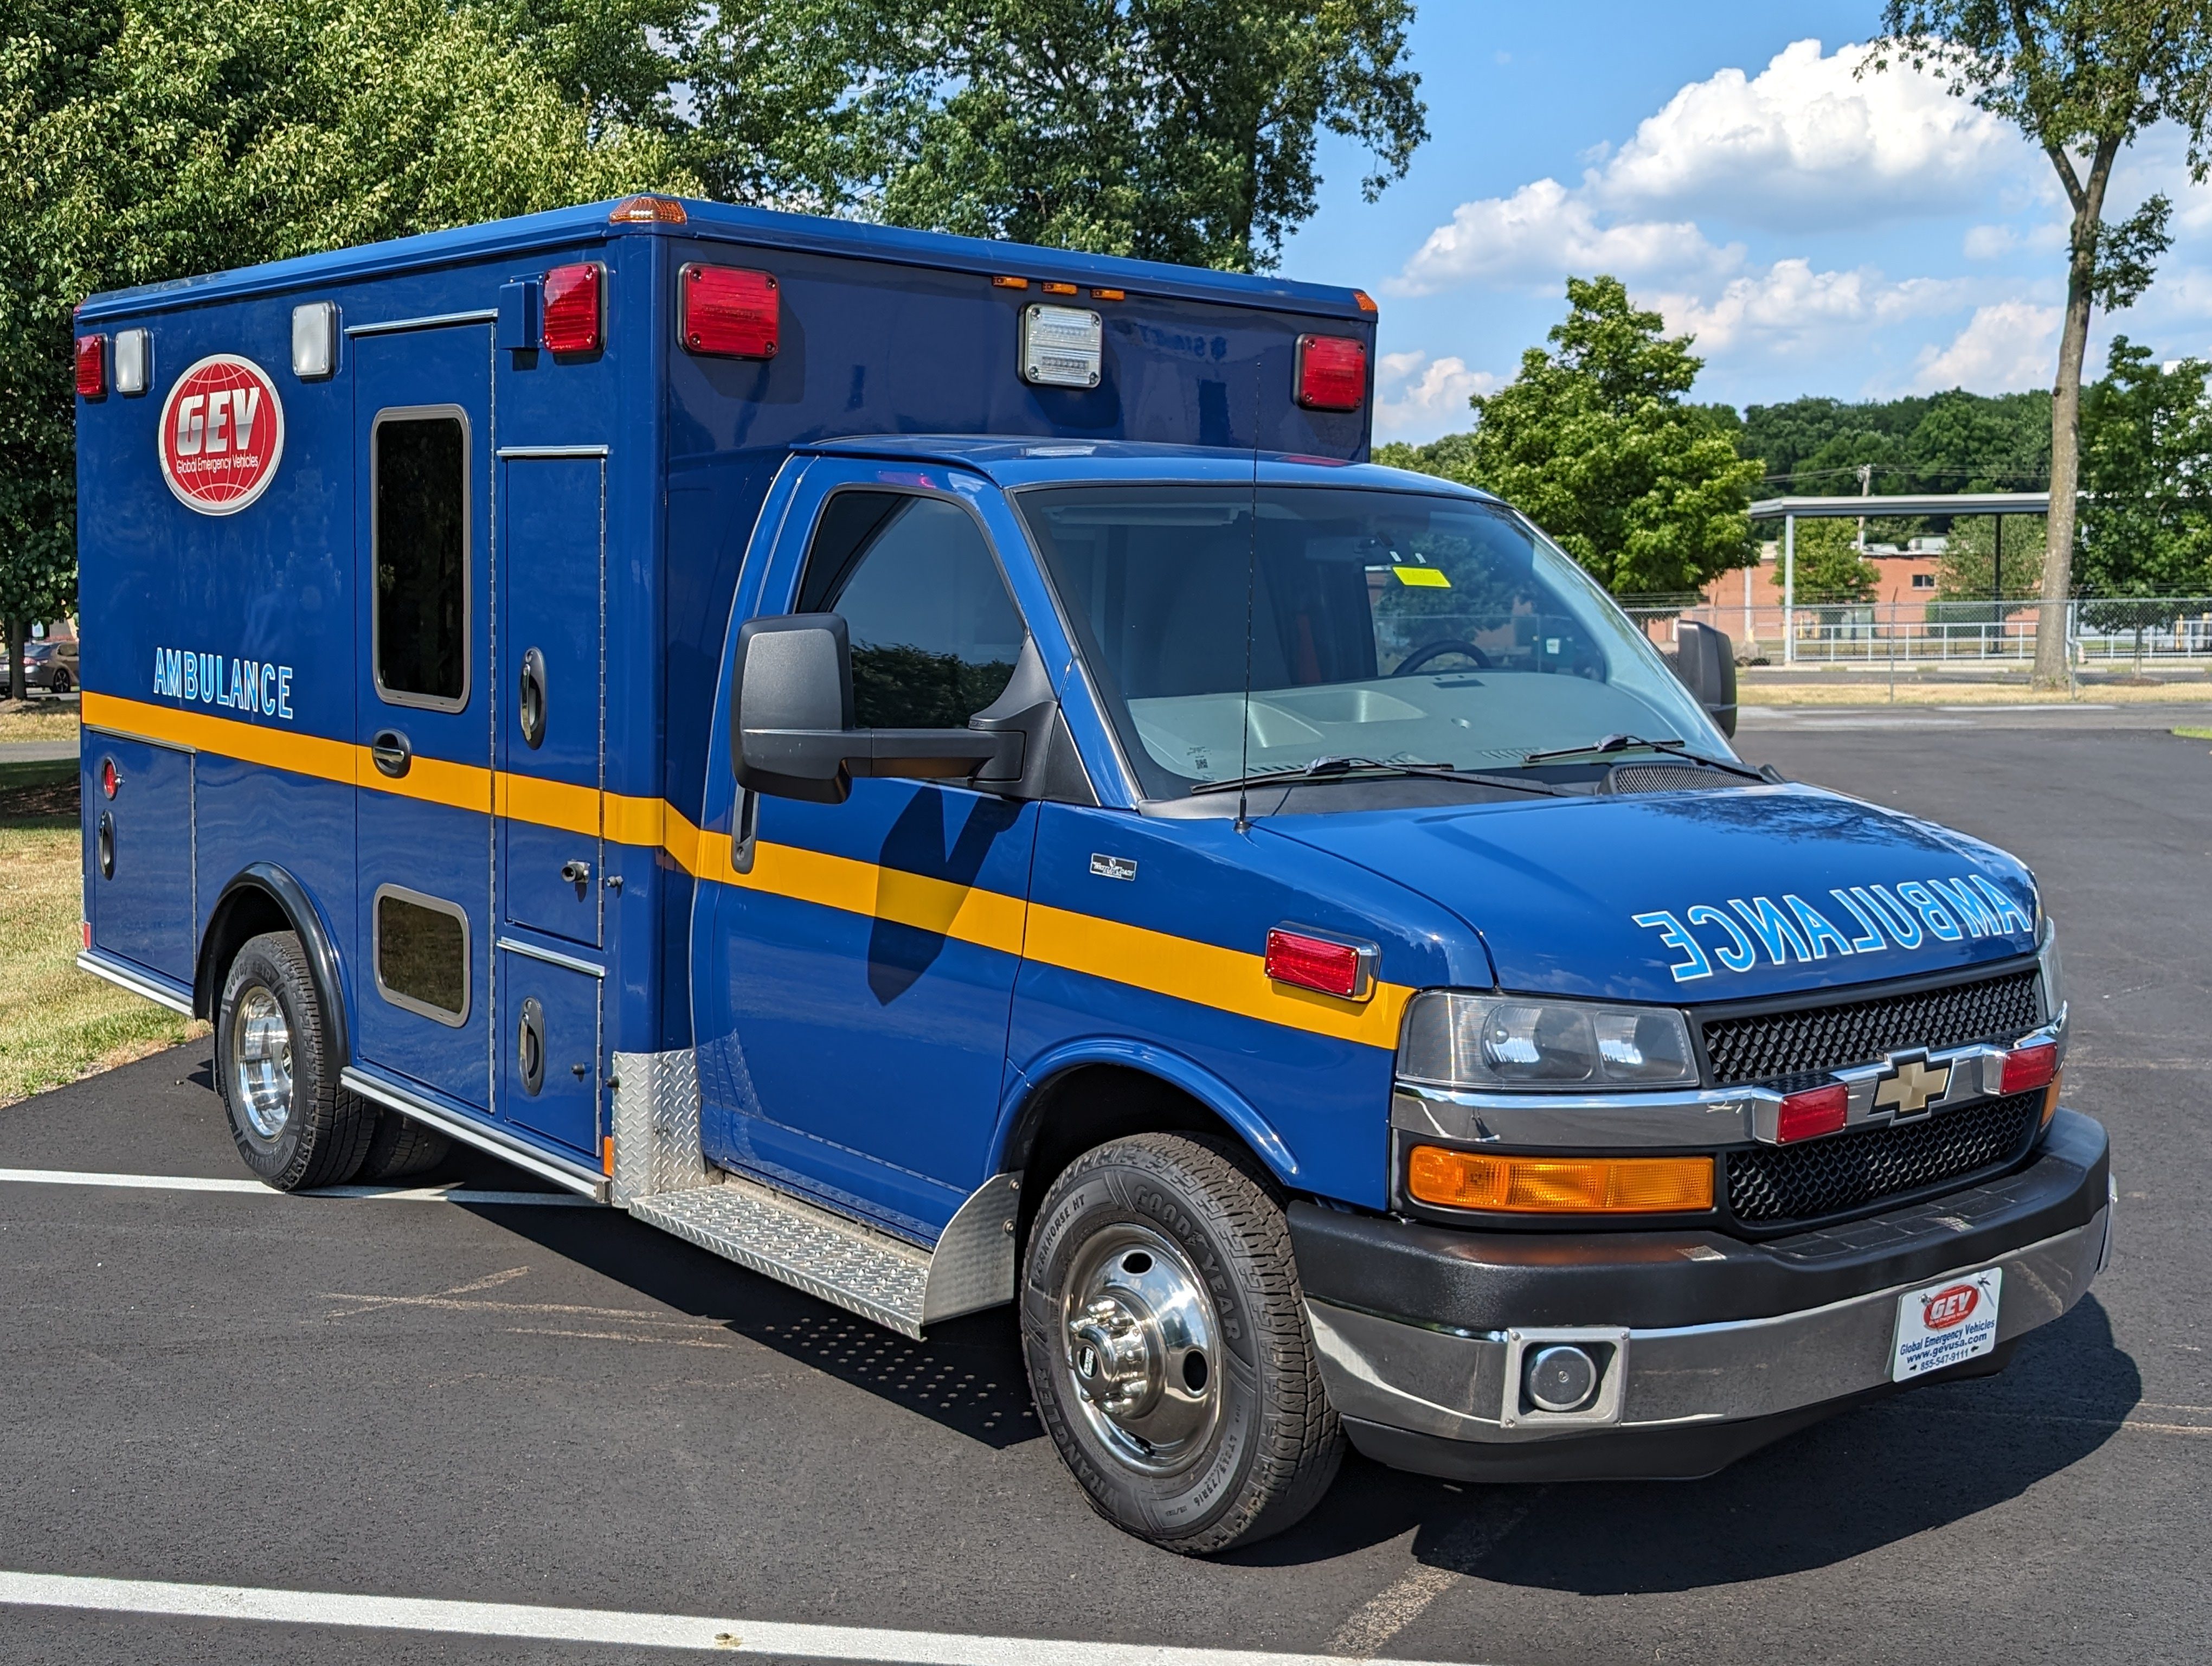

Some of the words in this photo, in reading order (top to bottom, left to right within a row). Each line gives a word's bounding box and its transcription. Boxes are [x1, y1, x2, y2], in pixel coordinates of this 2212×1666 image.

[177, 387, 260, 456] GEV
[176, 457, 197, 474] Global
[197, 457, 232, 474] Emergency
[232, 453, 259, 468] Vehicles
[153, 647, 293, 720] AMBULANCE
[1072, 1194, 1085, 1211] HT
[1135, 1185, 1242, 1340] GOODYEAR
[1930, 1290, 1973, 1321] GEV
[1900, 1338, 1923, 1356] Global
[1924, 1329, 1963, 1348] Emergency
[1965, 1319, 1995, 1335] Vehicles
[1906, 1332, 1988, 1364] www.gevusa.com
[1920, 1348, 1969, 1372] 855-547-9111
